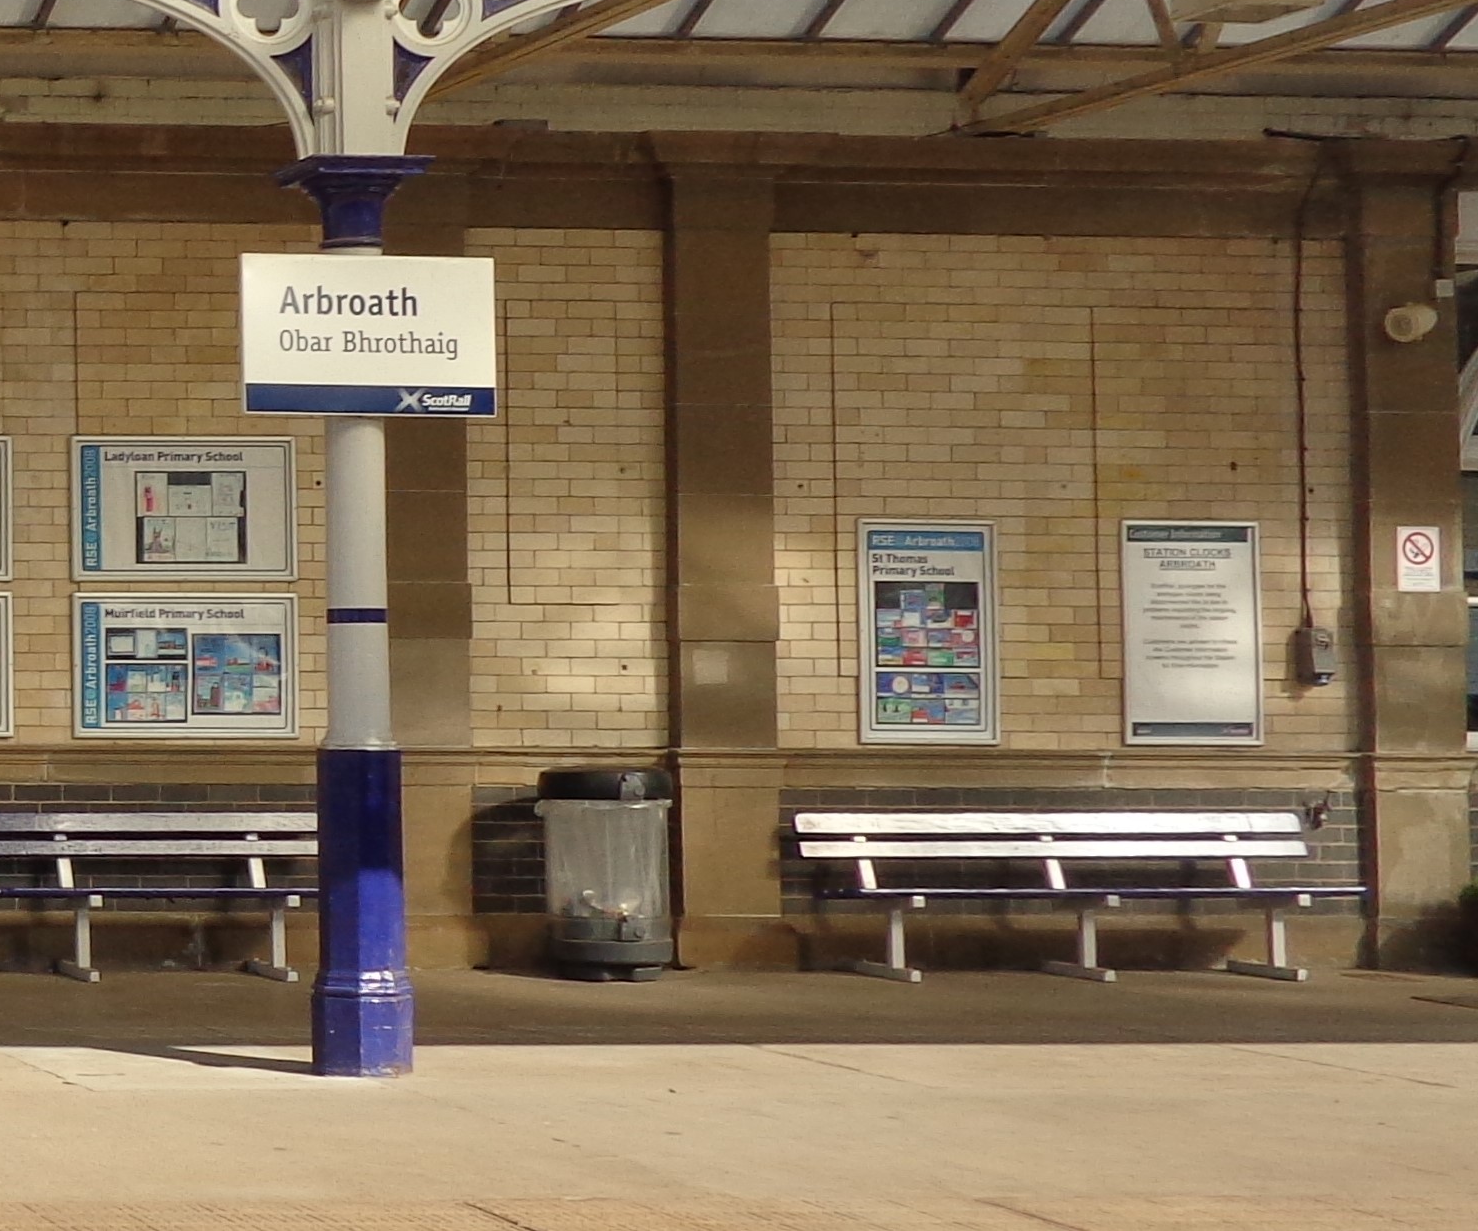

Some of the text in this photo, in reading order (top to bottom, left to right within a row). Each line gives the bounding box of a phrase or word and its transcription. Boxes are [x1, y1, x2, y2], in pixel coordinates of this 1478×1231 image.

[279, 286, 418, 316] Arbroath
[279, 329, 458, 360] Obar Bhrothaig
[422, 394, 472, 406] ScotRail
[104, 451, 243, 464] Ladyloan Primary School
[872, 553, 928, 564] St Thomas
[1144, 548, 1231, 558] STATION CLOCKS
[1159, 560, 1216, 568] ARBROATH
[872, 566, 955, 577] Primary School
[105, 609, 245, 620] Muirfield Primary School
